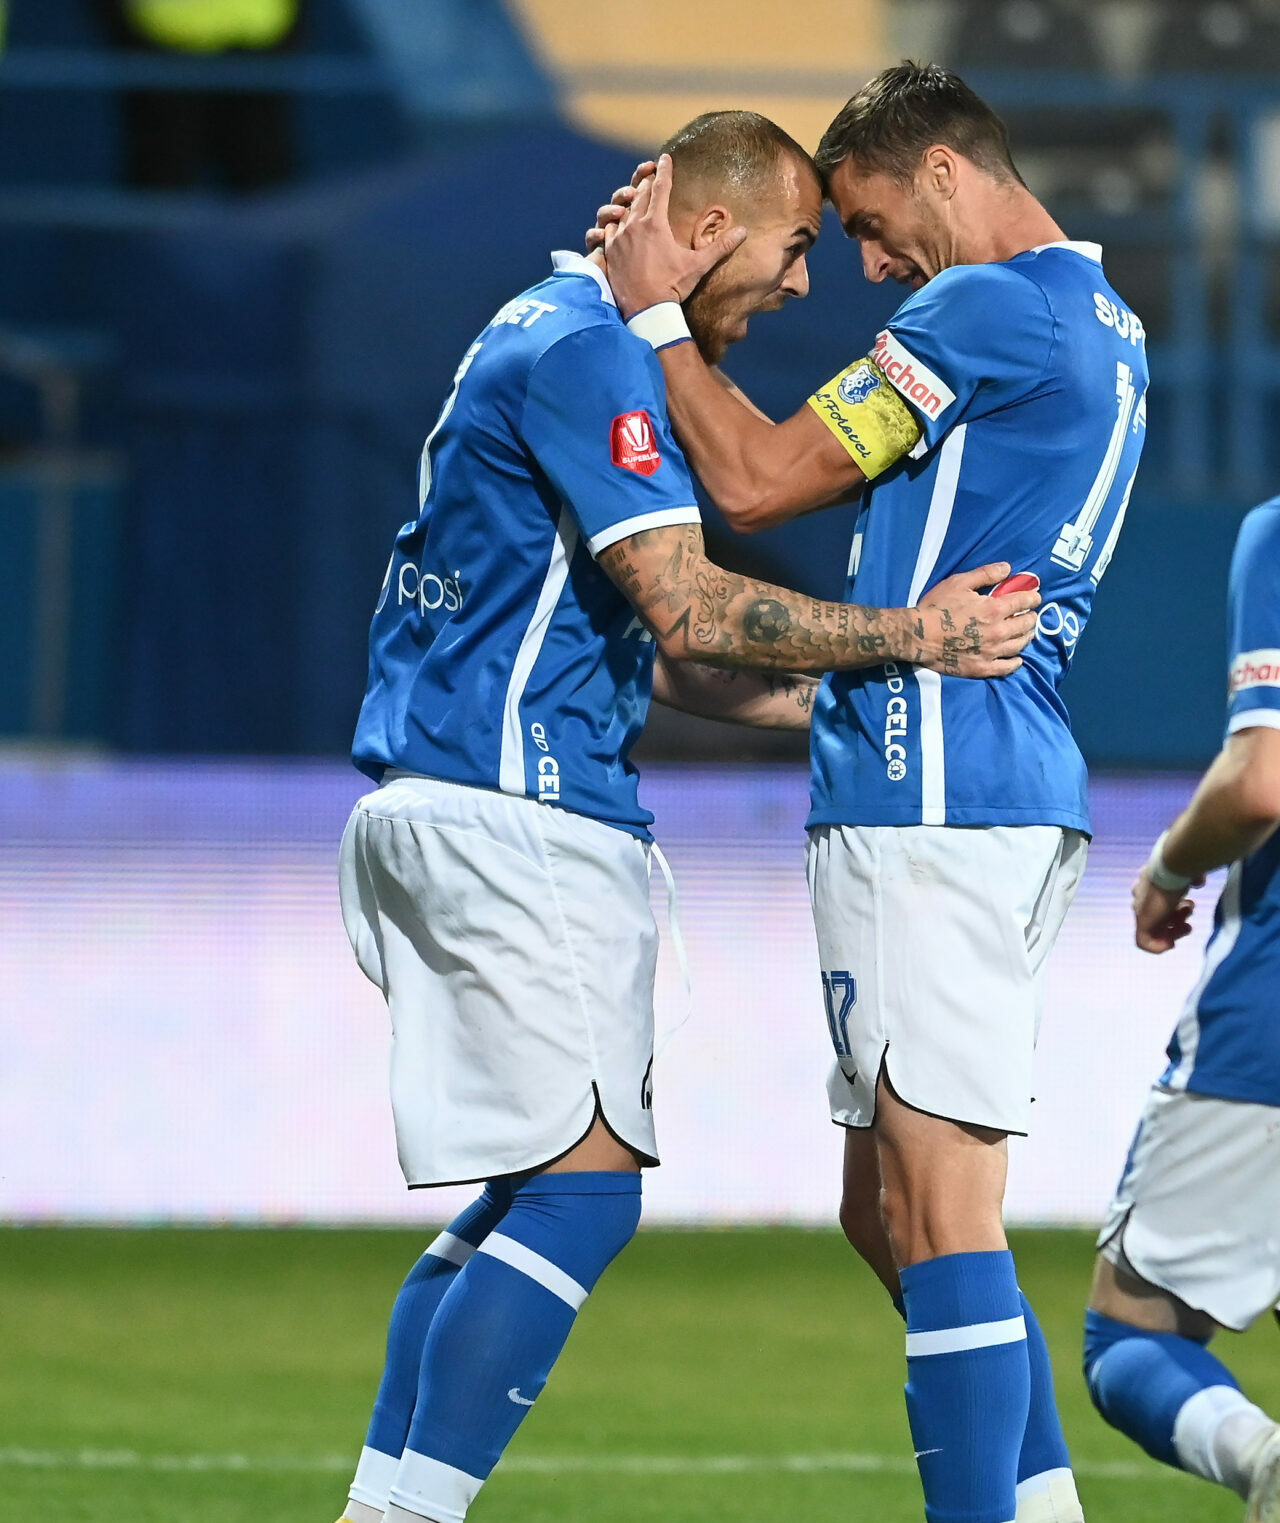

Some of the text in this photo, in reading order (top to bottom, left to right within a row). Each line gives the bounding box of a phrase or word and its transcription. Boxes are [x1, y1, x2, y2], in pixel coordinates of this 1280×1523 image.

[1093, 292, 1146, 354] SUP
[398, 562, 463, 617] ppsi
[537, 756, 560, 801] CEL
